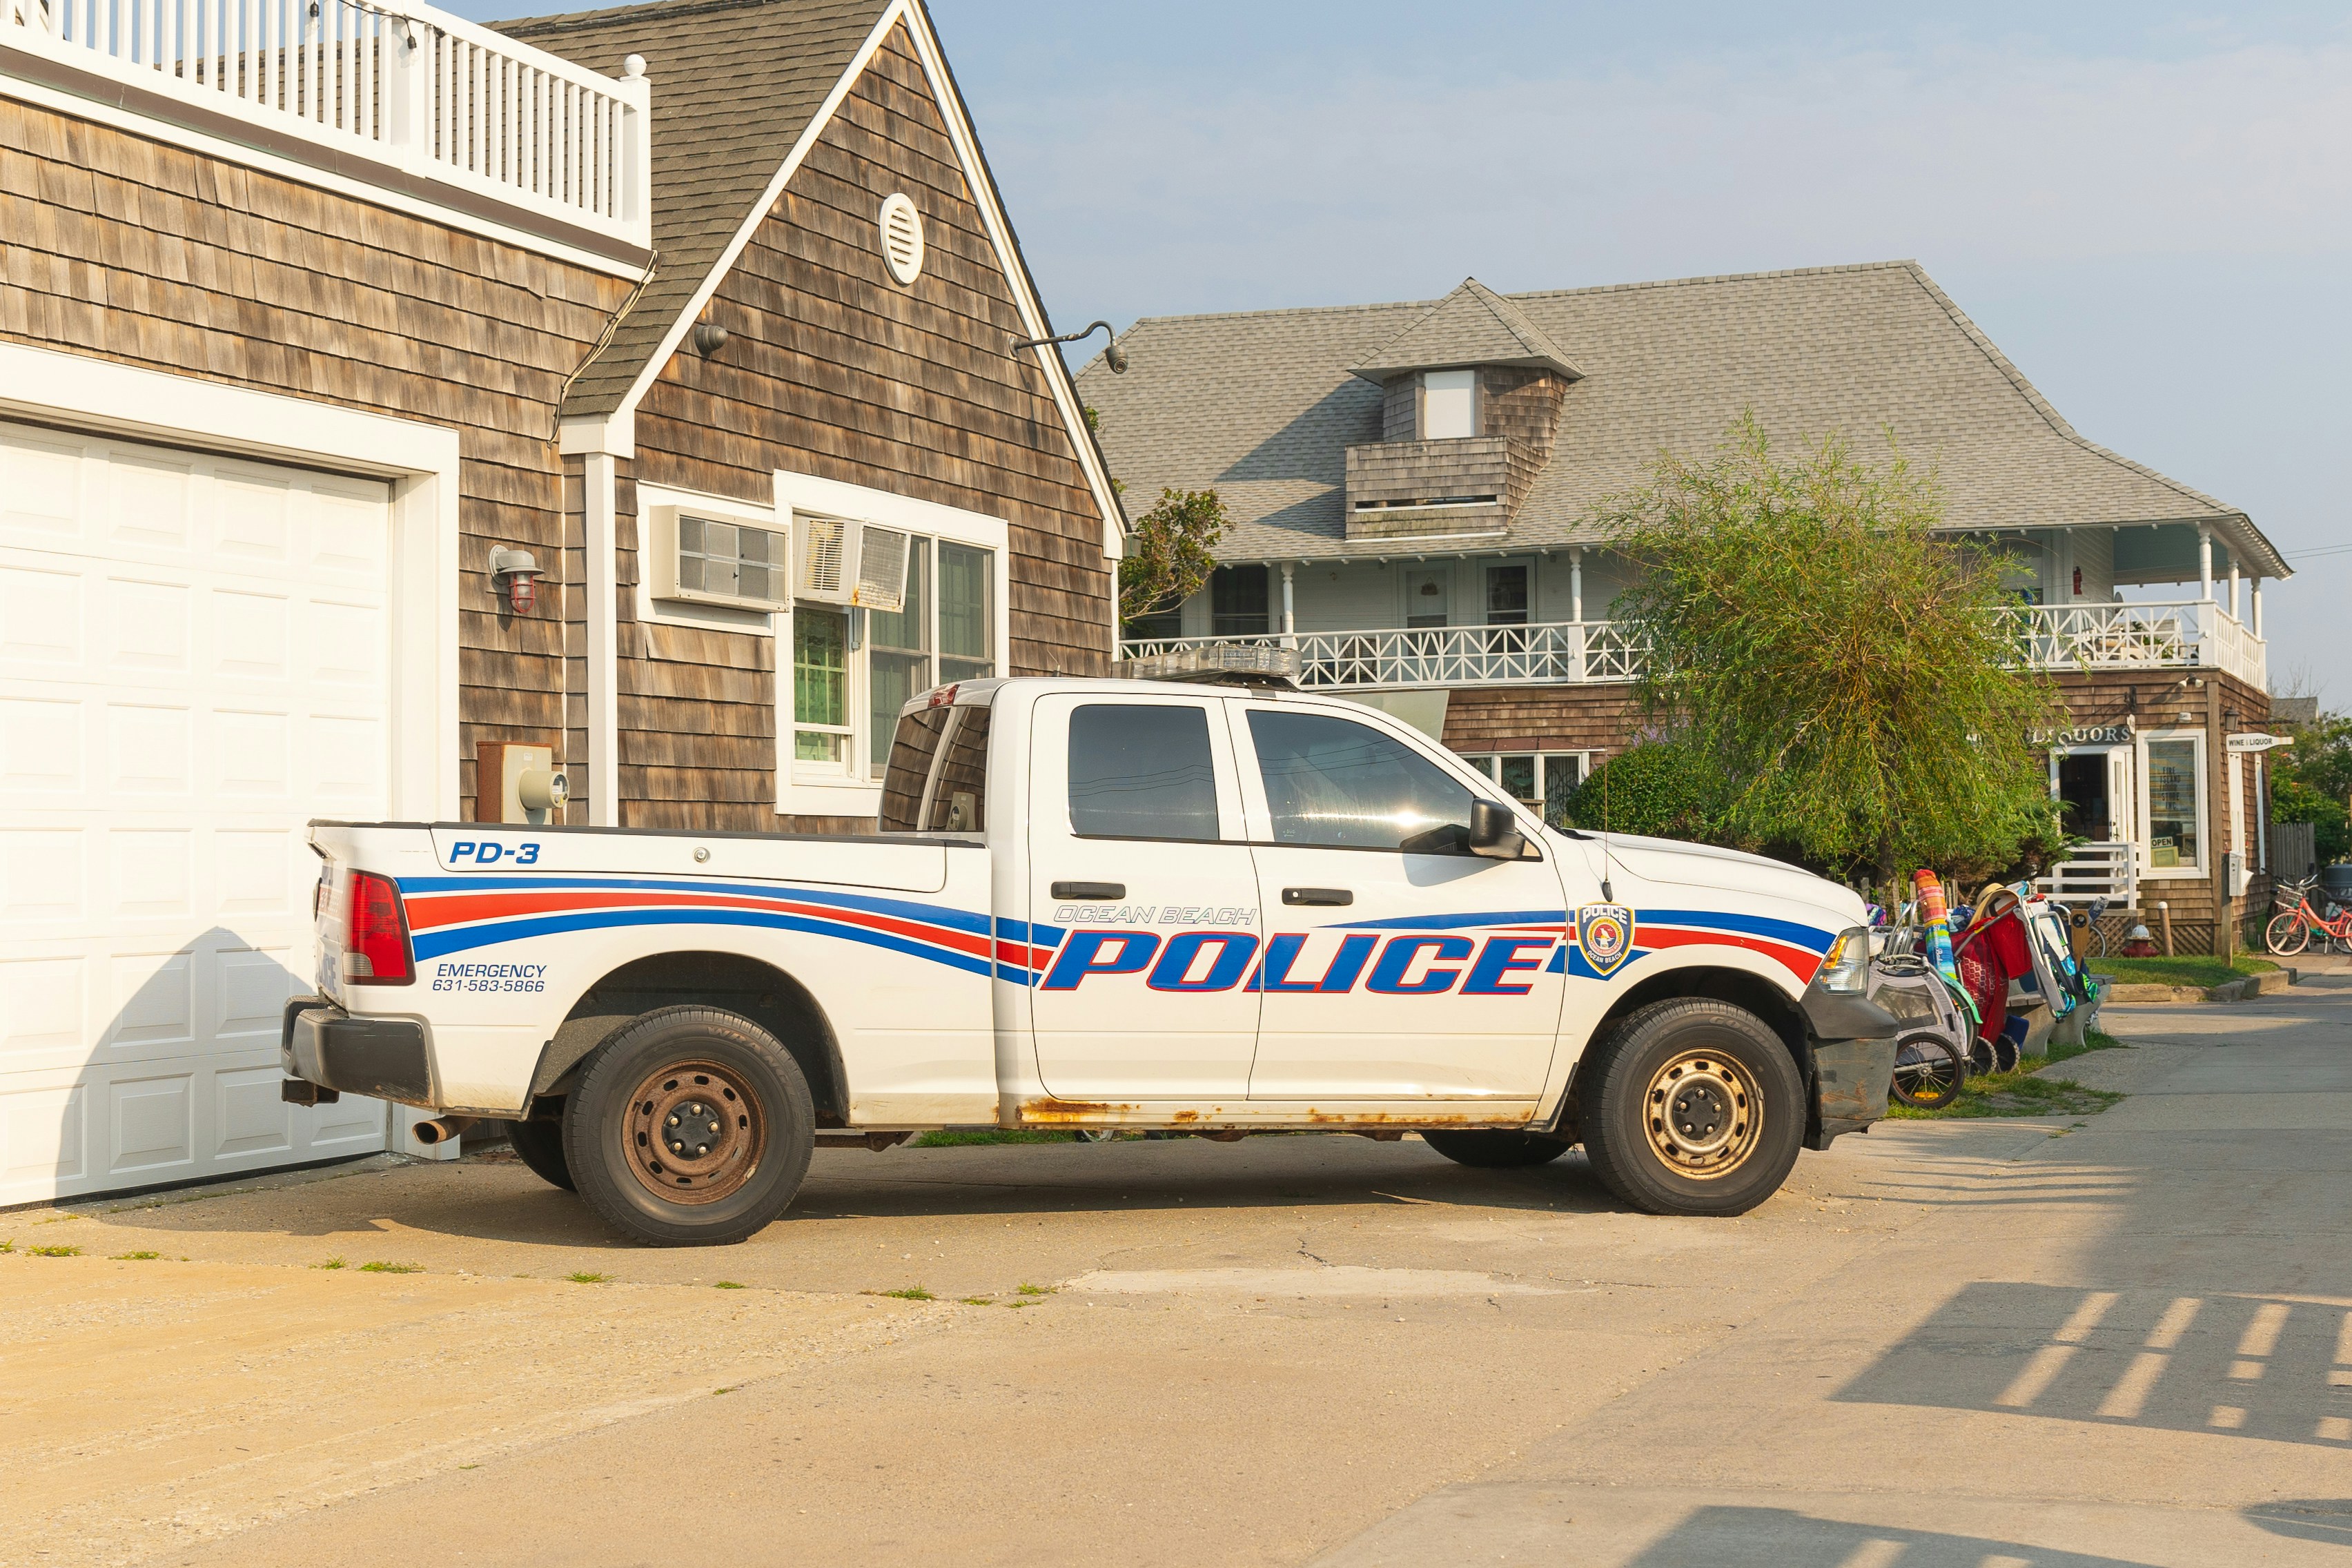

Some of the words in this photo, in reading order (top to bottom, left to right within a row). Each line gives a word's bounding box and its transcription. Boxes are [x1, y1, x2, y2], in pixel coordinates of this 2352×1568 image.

[2151, 838, 2173, 847] OPEN
[449, 842, 540, 864] PD-3
[1053, 905, 1156, 923] OCEAN
[1158, 906, 1257, 925] BEACH
[1582, 904, 1628, 925] POLICE
[1039, 929, 1557, 995] POLICE
[1587, 950, 1604, 963] OCEAN
[1605, 951, 1623, 963] BEACH
[437, 963, 547, 978] EMERGENCY
[433, 979, 545, 992] 631-583-5866
